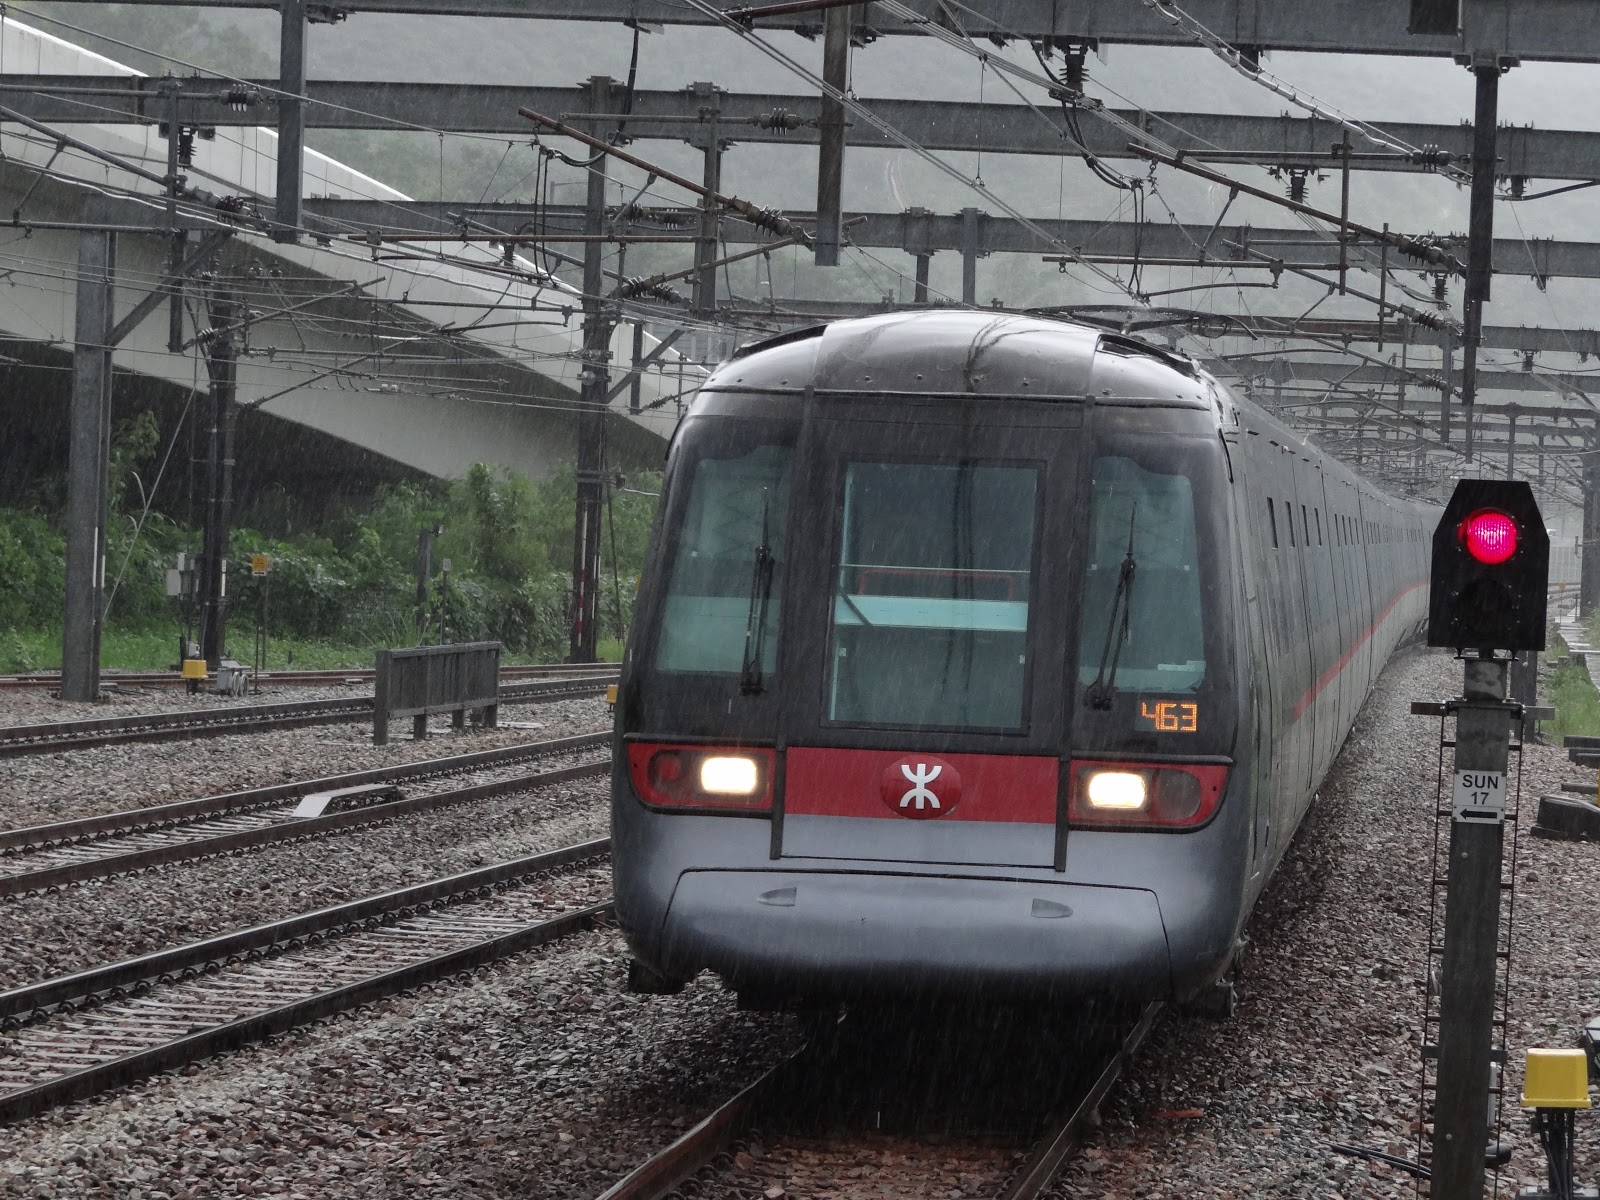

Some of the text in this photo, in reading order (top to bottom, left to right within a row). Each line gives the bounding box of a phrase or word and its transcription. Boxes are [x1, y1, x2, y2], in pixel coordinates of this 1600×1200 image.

[1142, 702, 1197, 731] 463
[1462, 774, 1498, 789] SUN
[1471, 791, 1489, 805] 17
